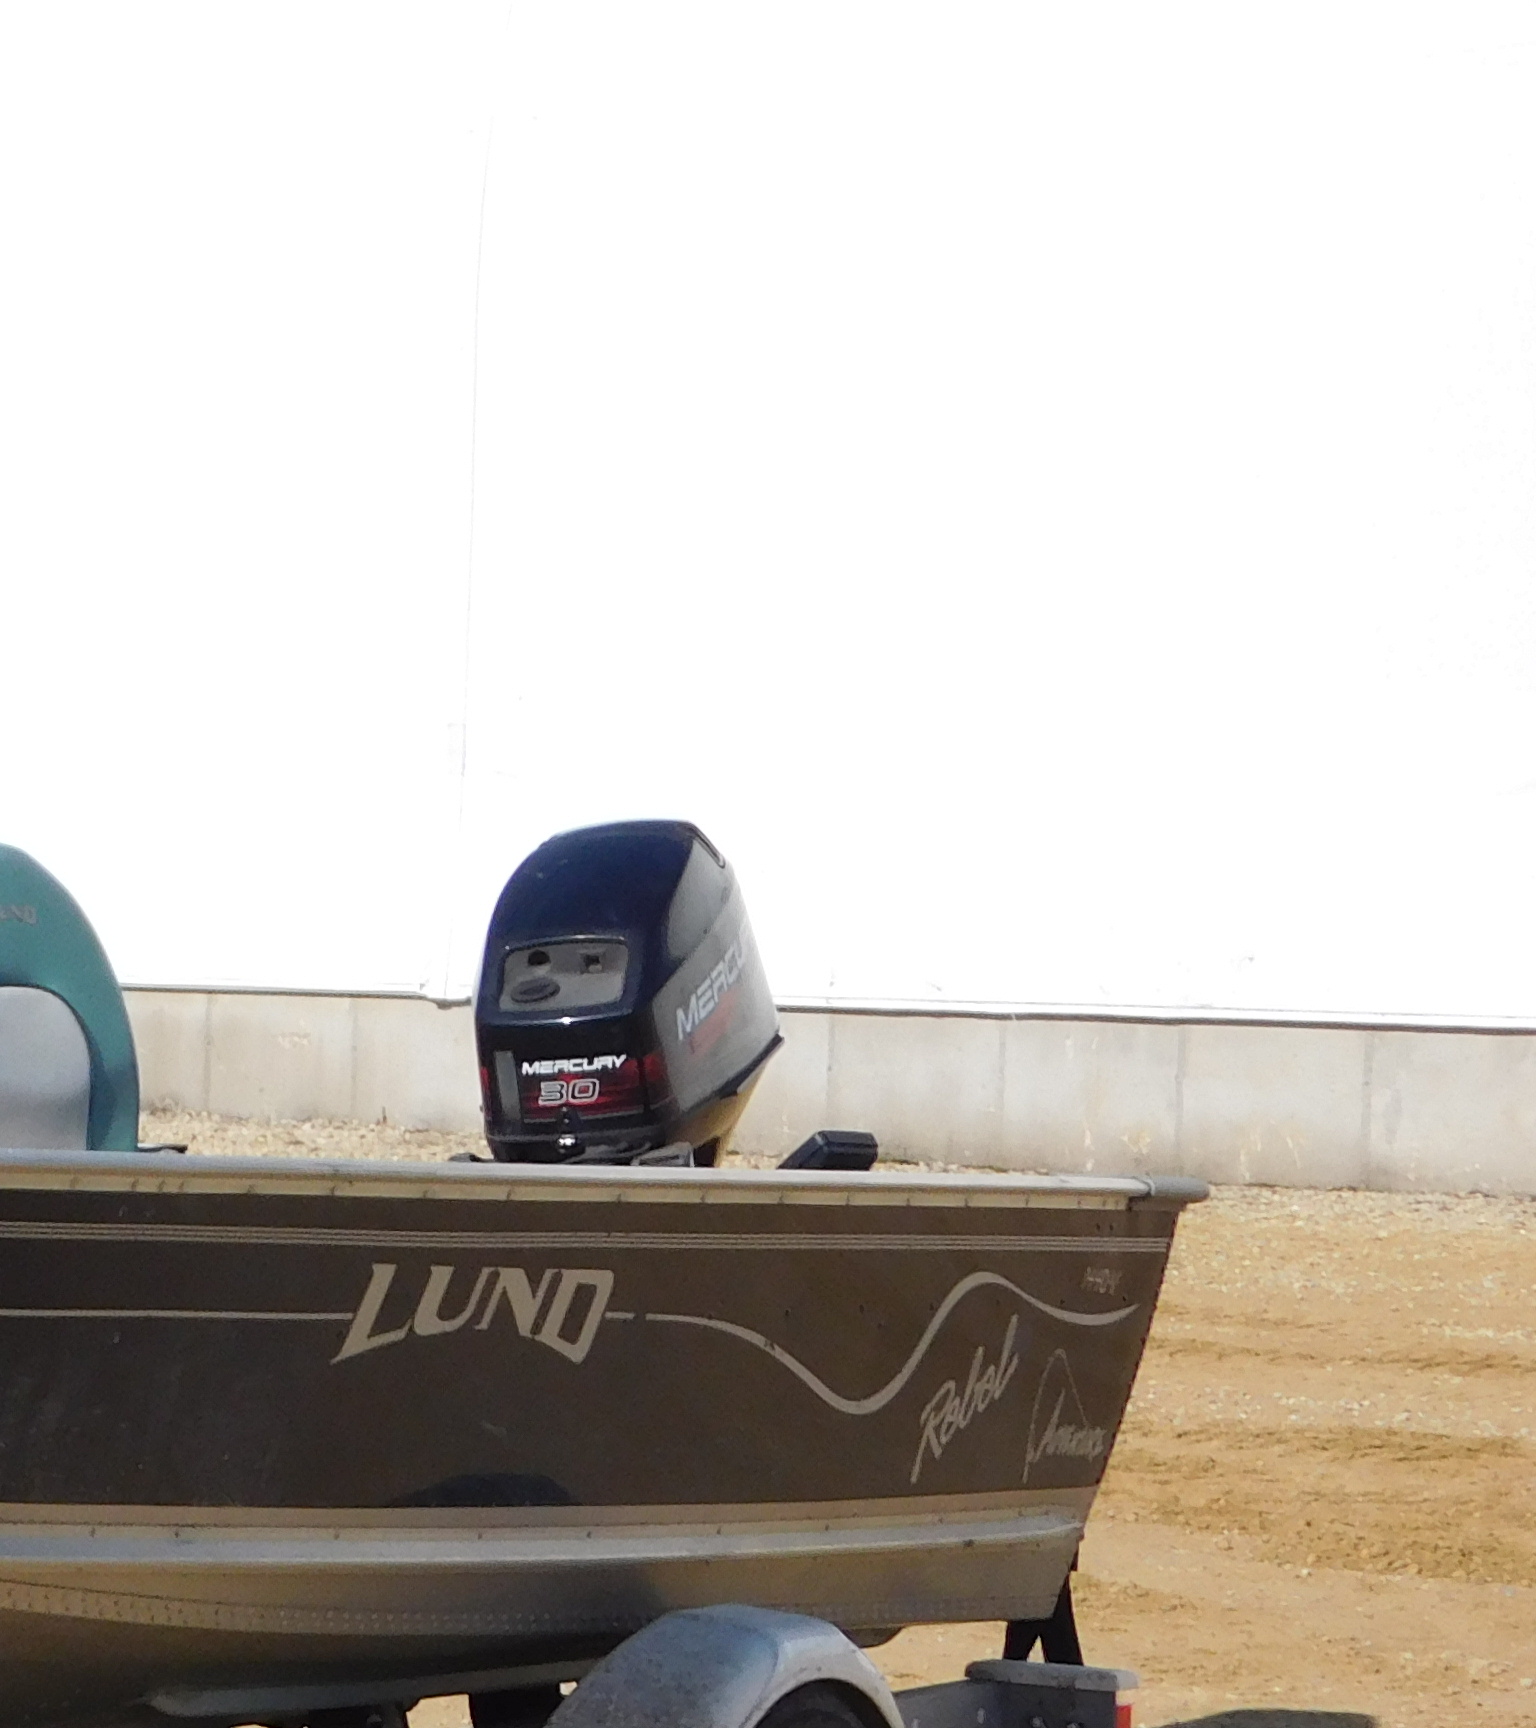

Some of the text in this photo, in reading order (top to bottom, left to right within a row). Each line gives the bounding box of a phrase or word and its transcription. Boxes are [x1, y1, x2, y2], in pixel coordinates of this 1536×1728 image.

[521, 1053, 627, 1076] MERCURY
[540, 1078, 600, 1106] 30
[330, 1262, 615, 1365] LUND
